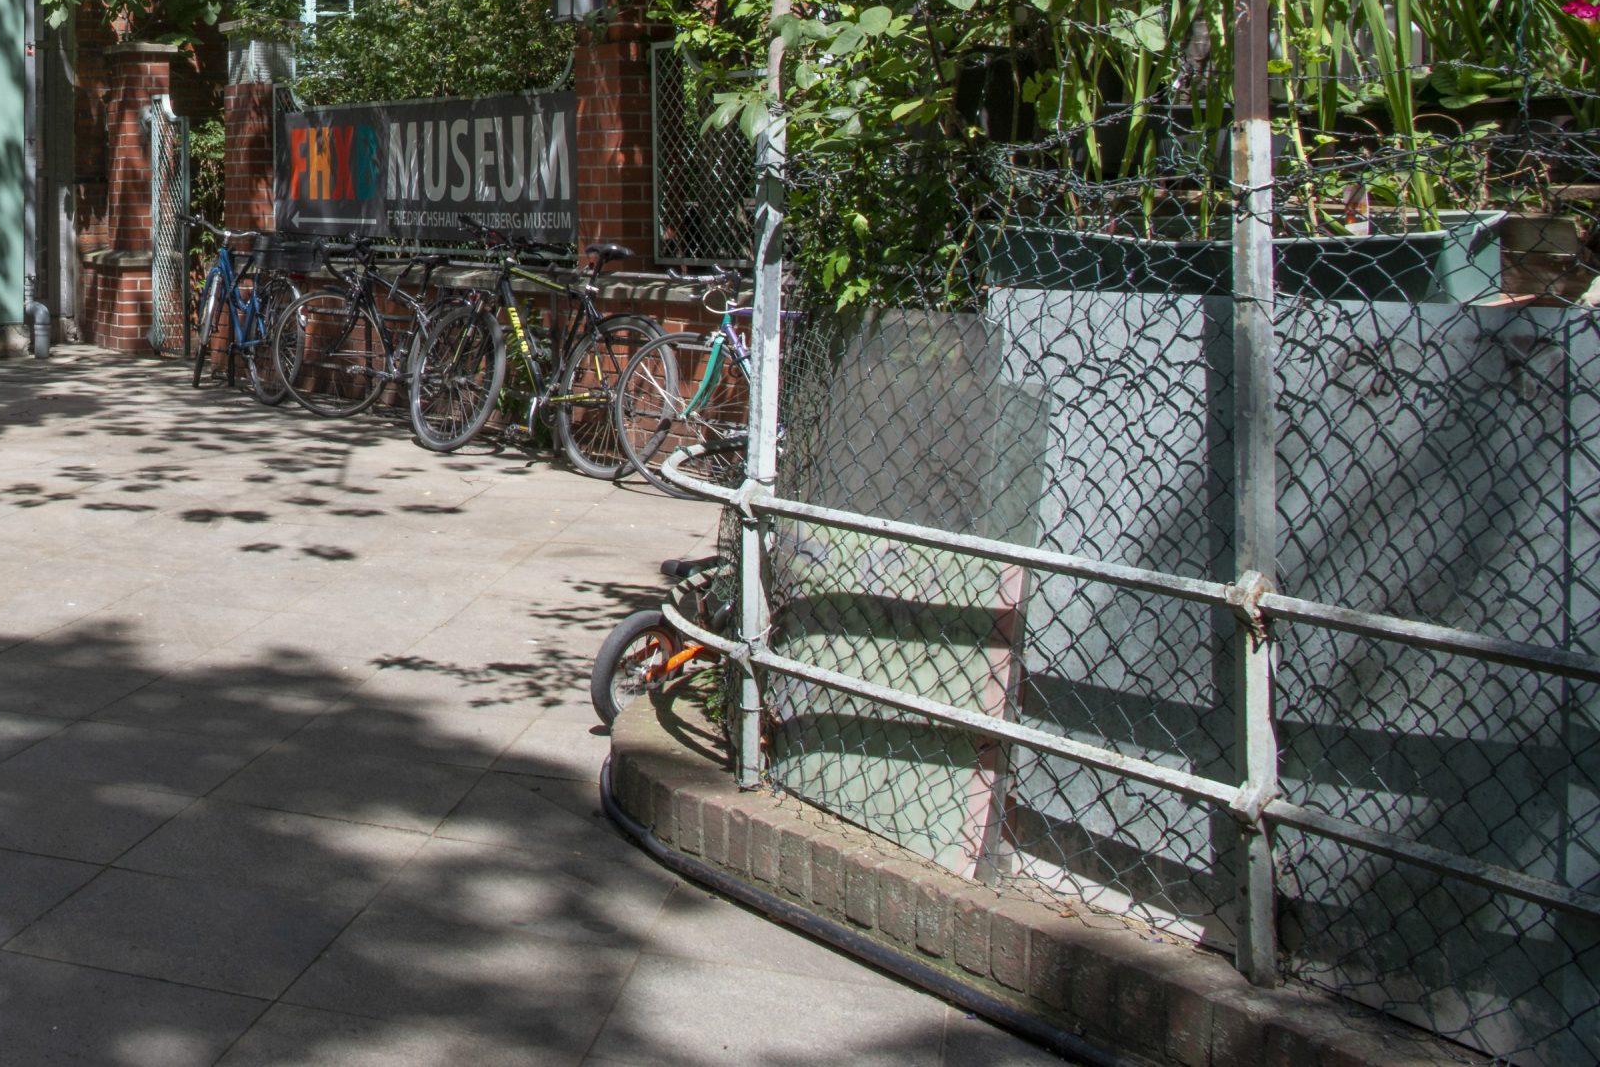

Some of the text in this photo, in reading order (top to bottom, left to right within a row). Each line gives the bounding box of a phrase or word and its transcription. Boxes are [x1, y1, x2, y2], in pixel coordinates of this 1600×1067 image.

[290, 110, 571, 203] FHXB MUSEUM
[525, 212, 572, 230] MUSEUM
